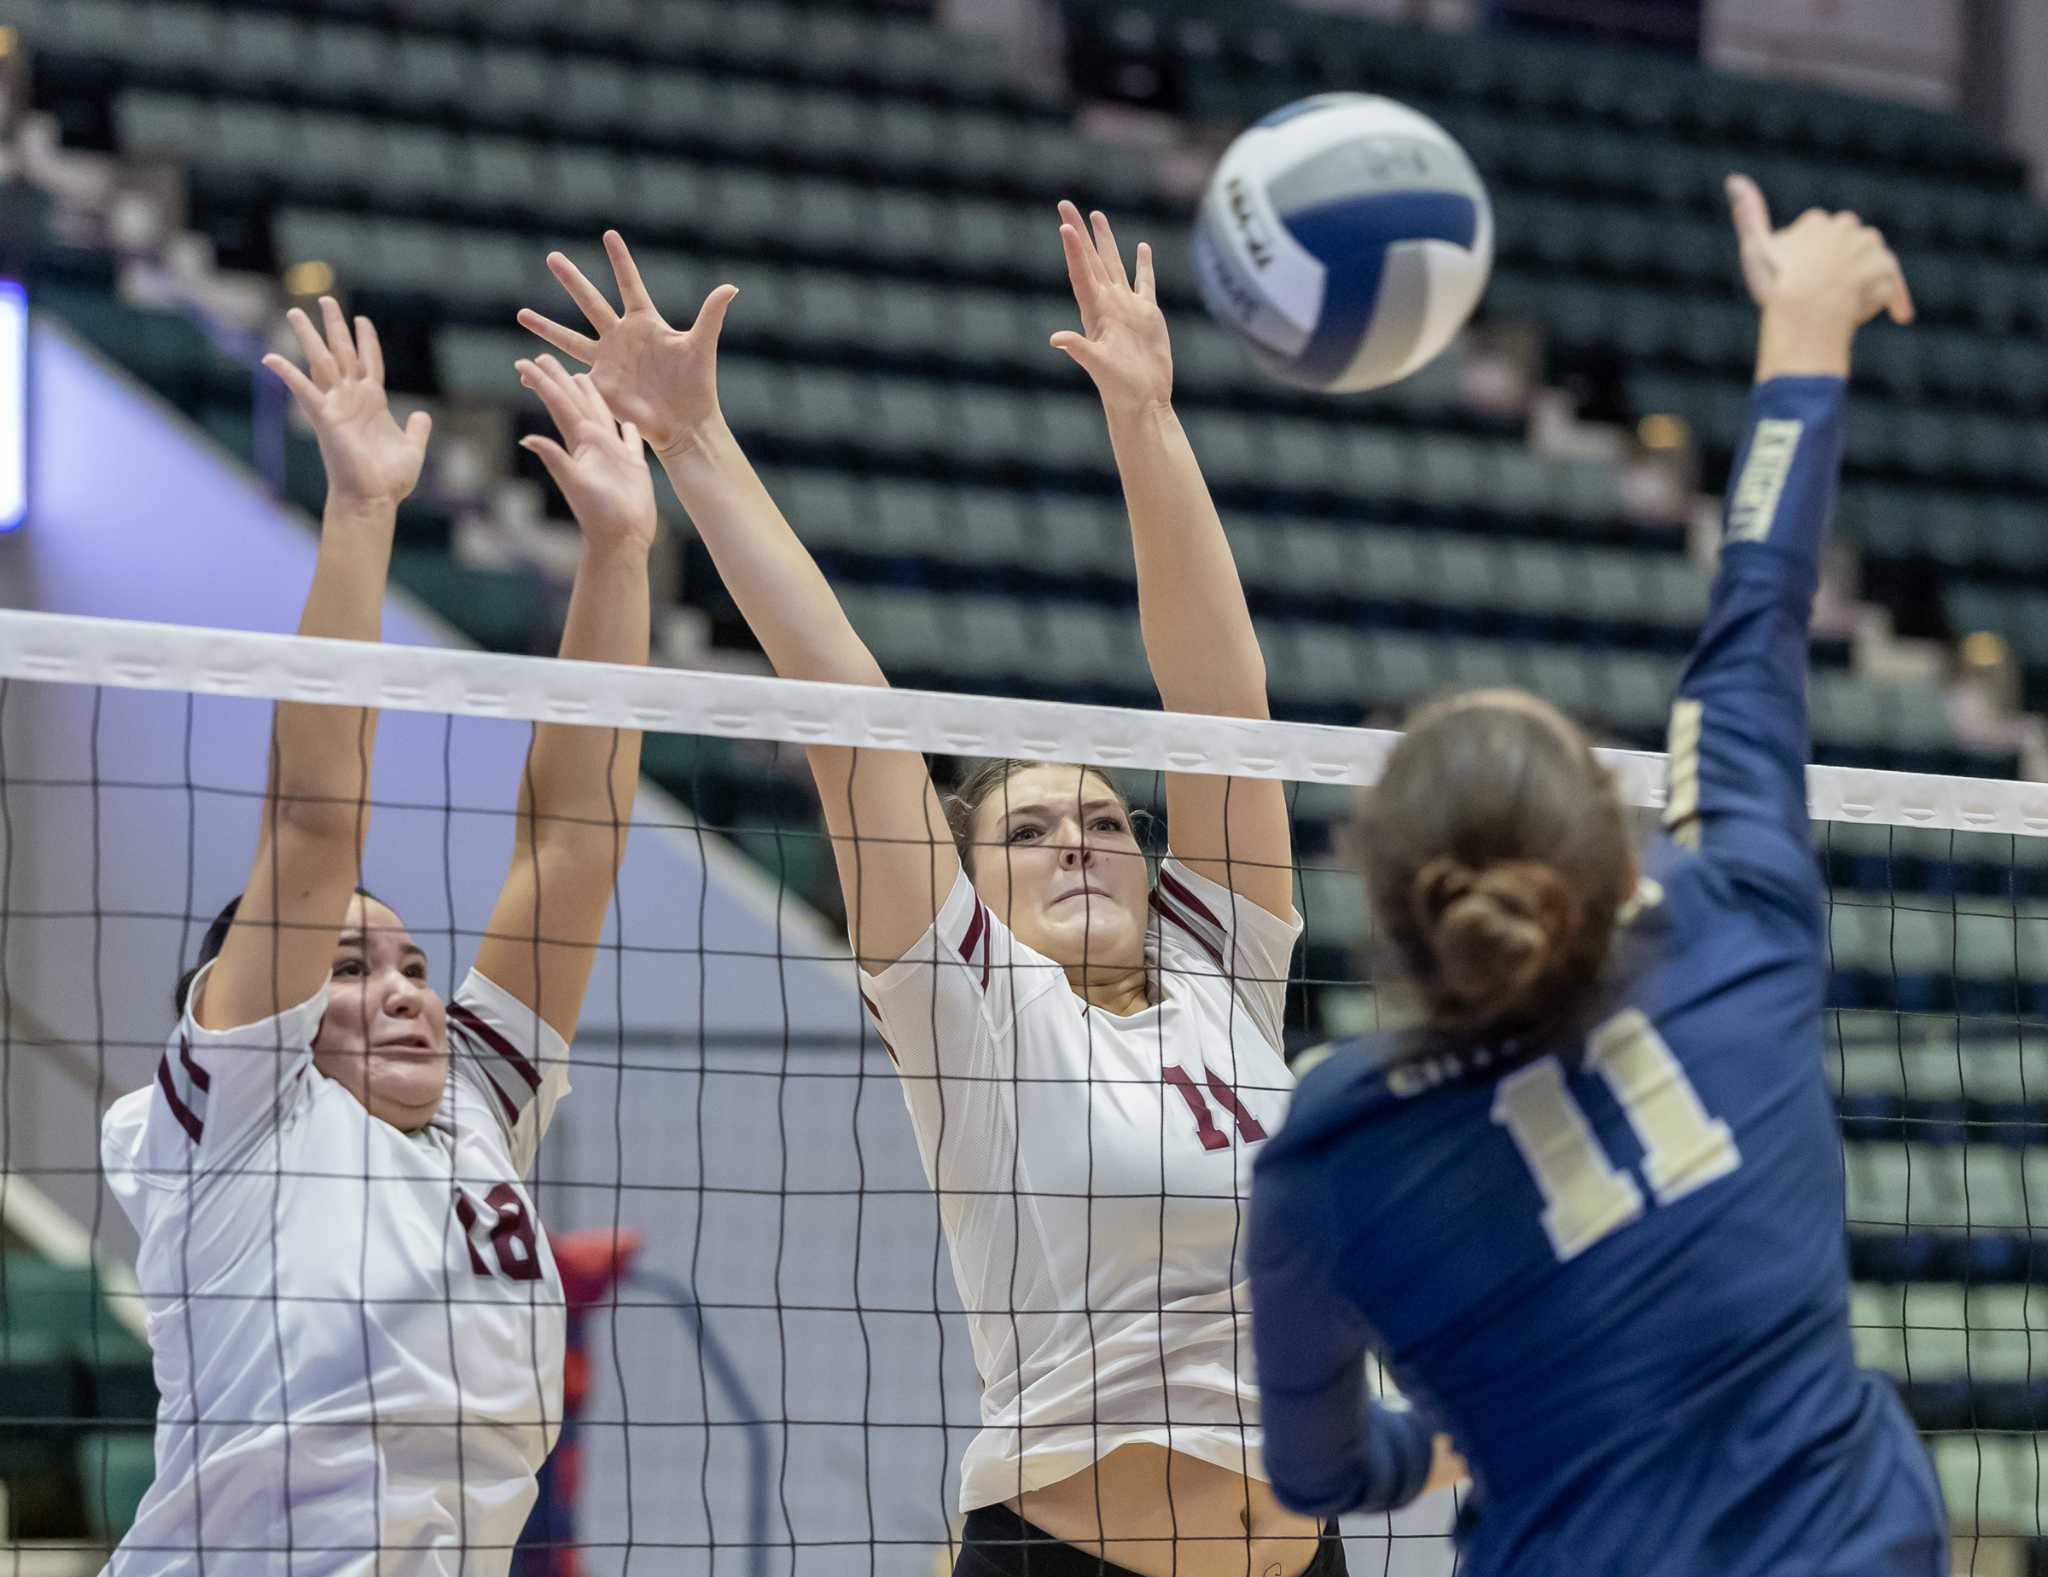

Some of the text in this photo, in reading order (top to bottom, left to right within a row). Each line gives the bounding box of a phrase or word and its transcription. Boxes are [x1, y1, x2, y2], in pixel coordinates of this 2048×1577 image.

[1161, 1064, 1269, 1152] 11
[1490, 1008, 1743, 1263] 11
[455, 1182, 544, 1281] 18
